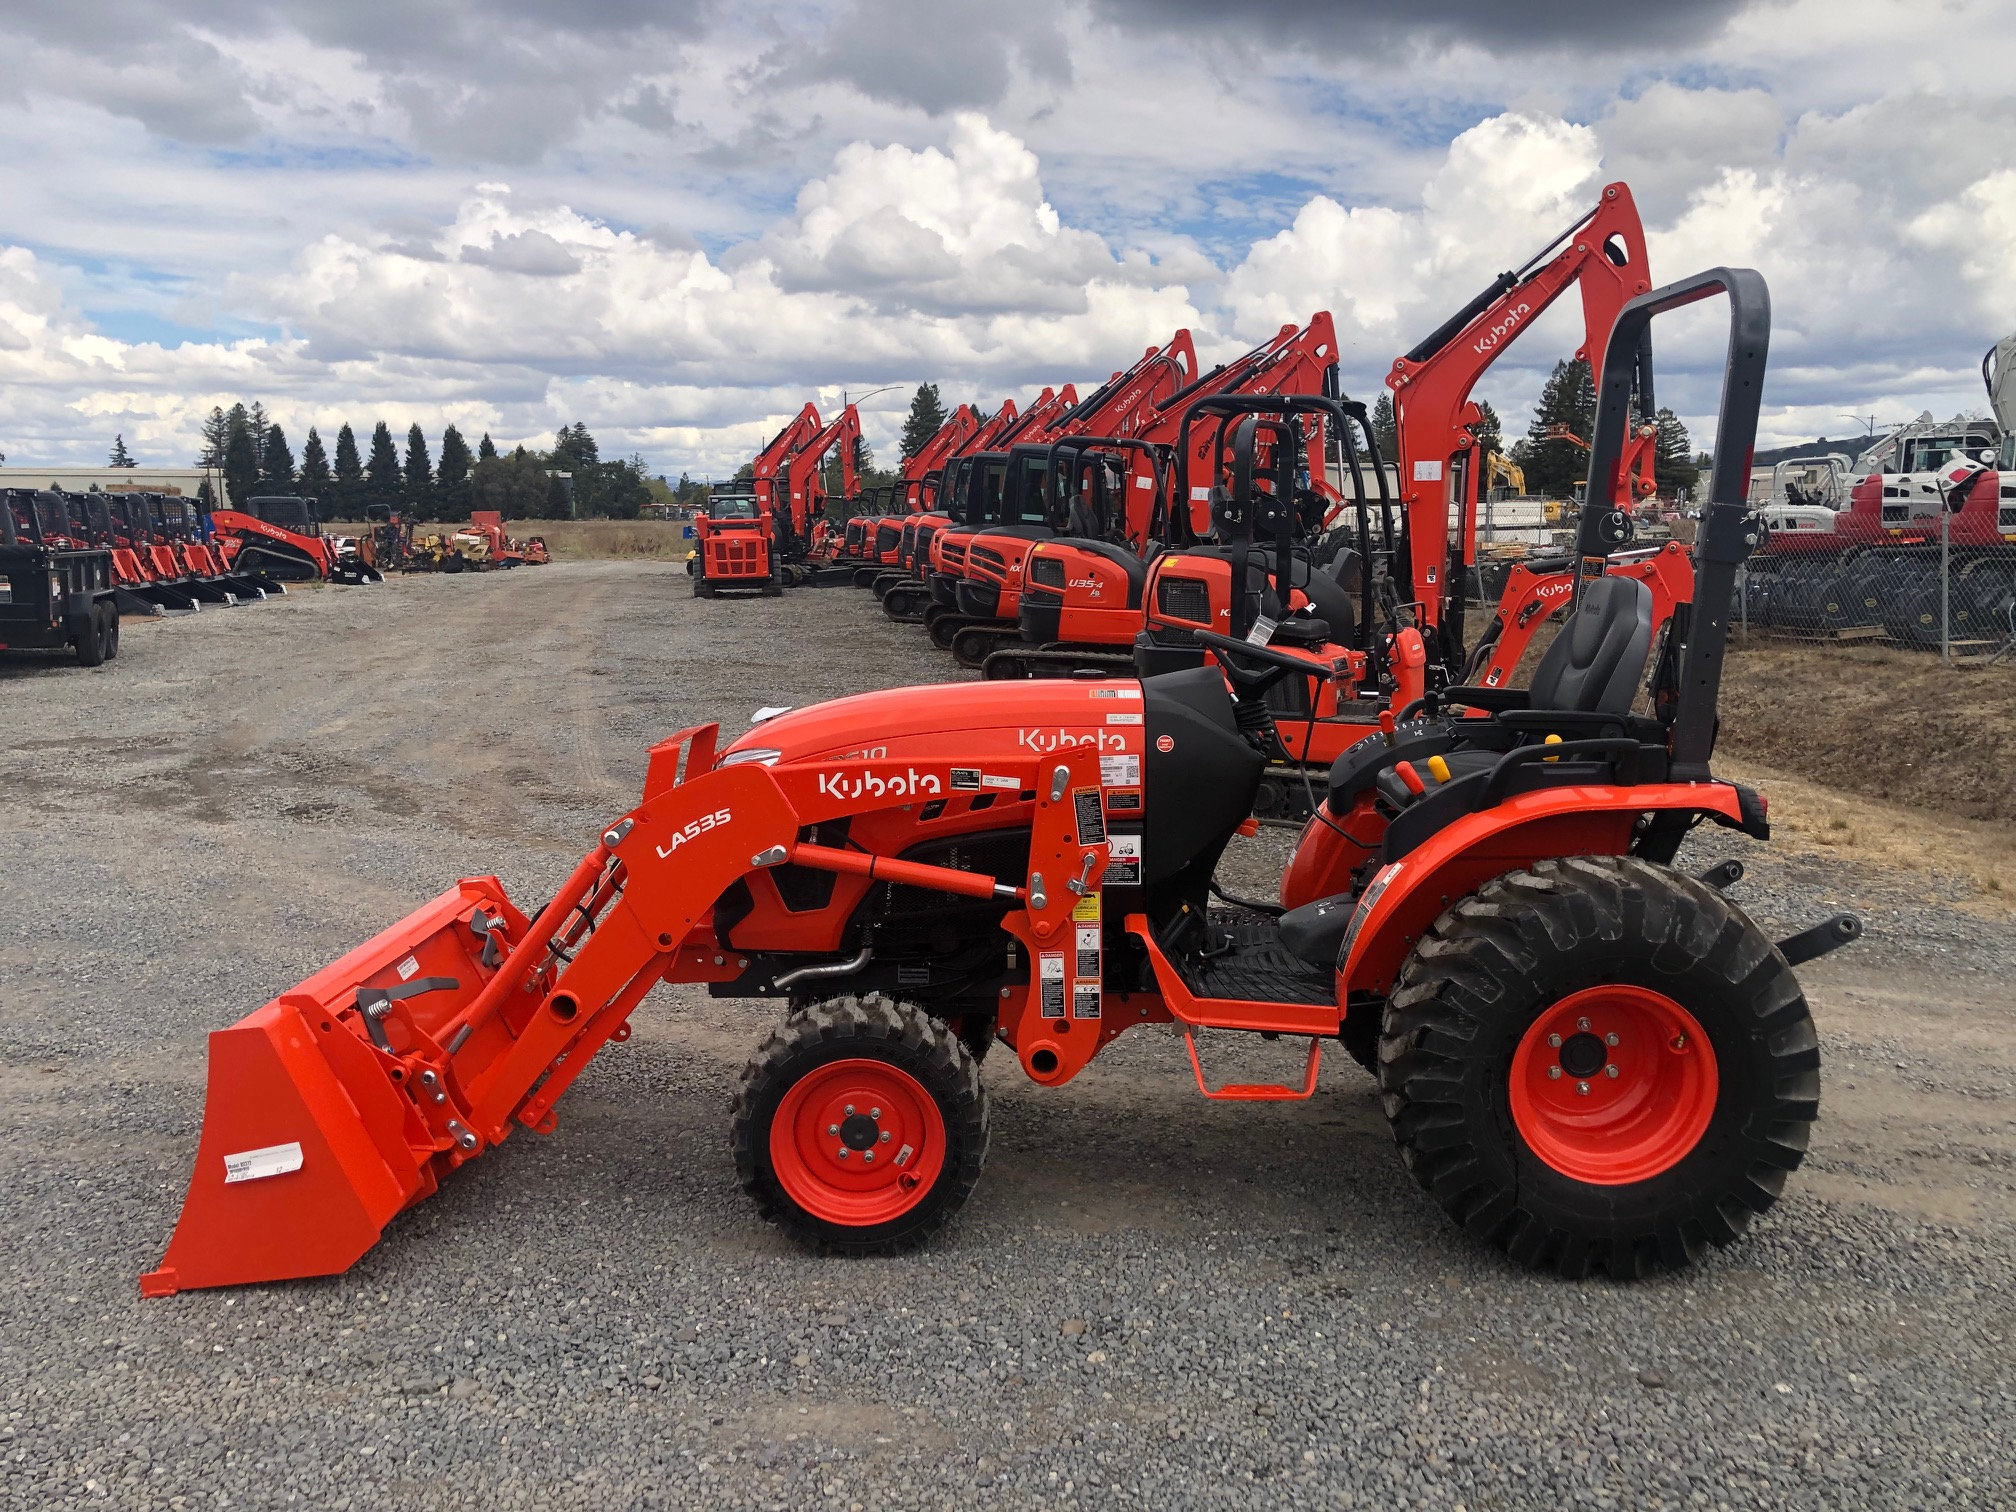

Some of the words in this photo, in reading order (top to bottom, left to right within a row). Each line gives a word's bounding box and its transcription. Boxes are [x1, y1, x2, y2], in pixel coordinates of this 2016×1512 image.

[1473, 303, 1531, 354] Kubota
[1114, 388, 1142, 413] Kubota
[1023, 424, 1041, 441] Kubota
[260, 523, 287, 540] Kubota
[1068, 579, 1104, 589] U35-4
[1018, 728, 1126, 752] Kubota
[818, 767, 941, 800] Kubota
[655, 807, 732, 859] LA535
